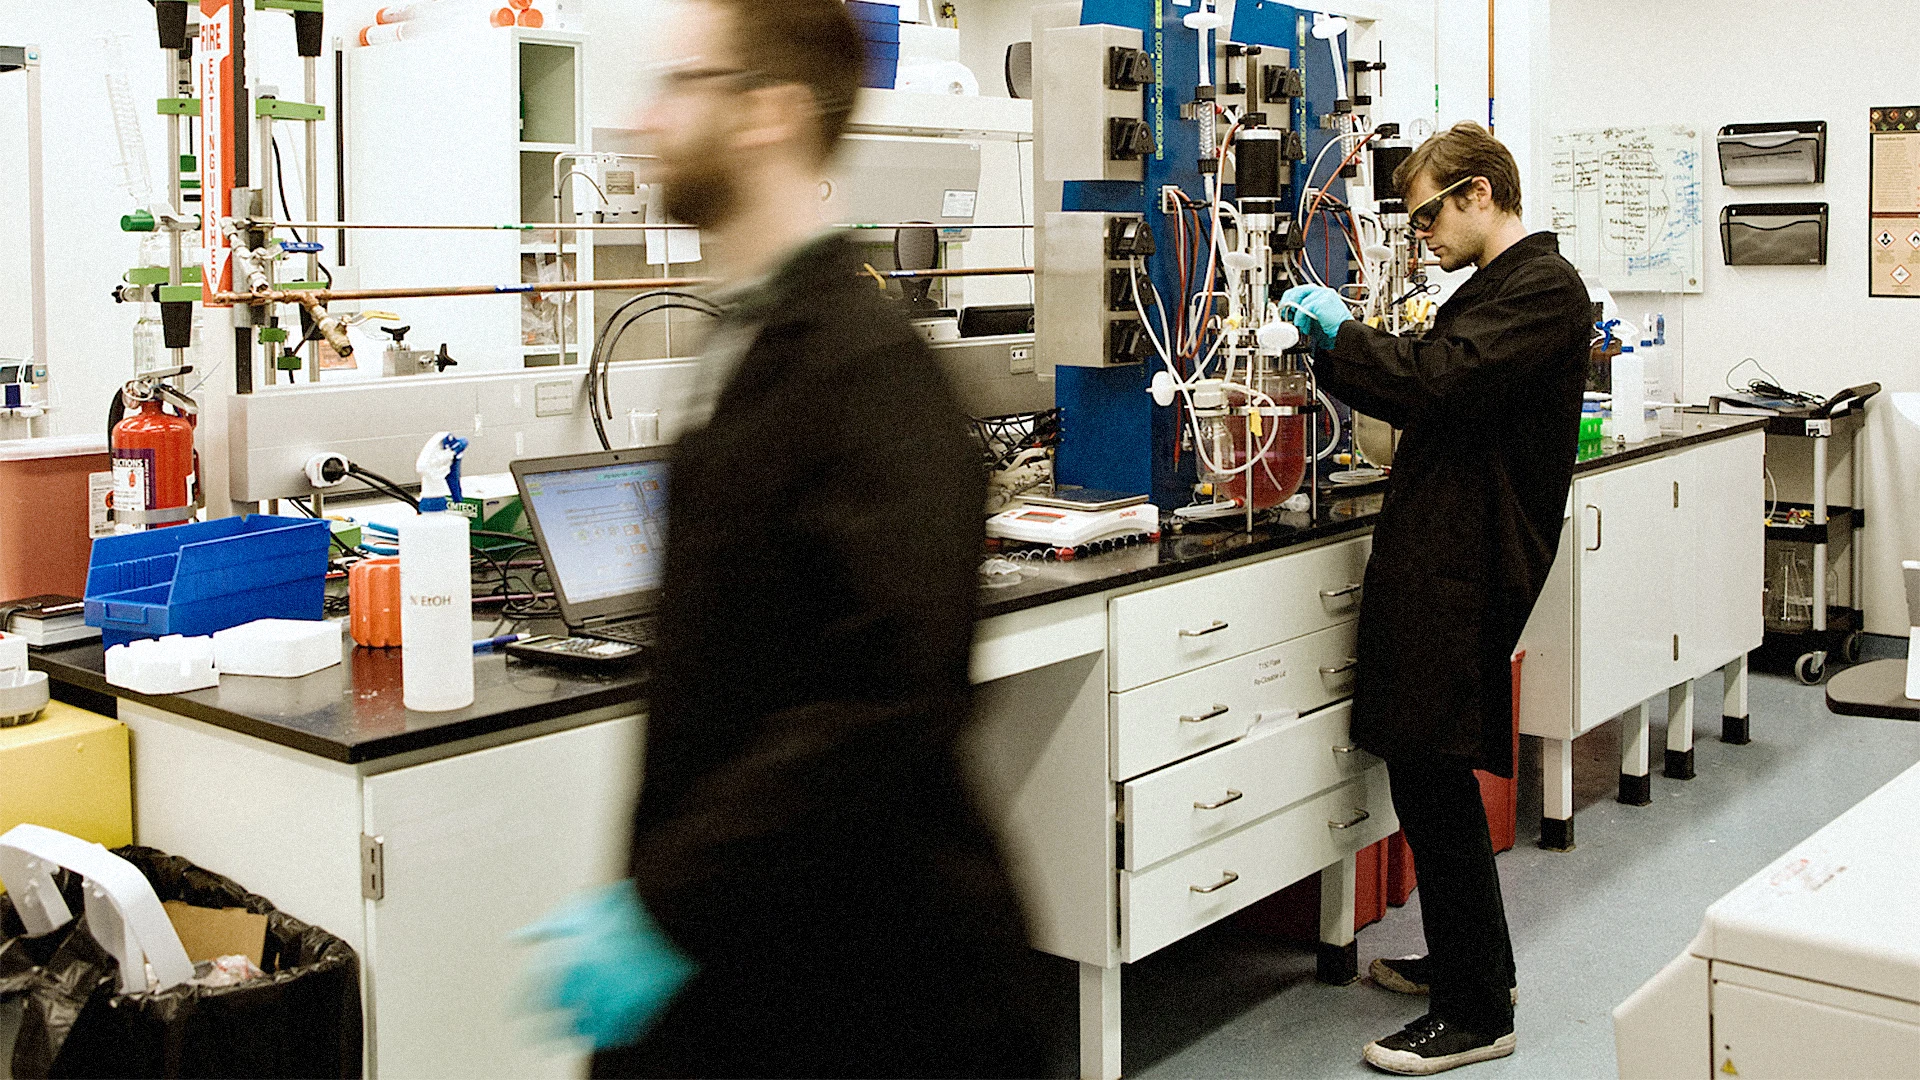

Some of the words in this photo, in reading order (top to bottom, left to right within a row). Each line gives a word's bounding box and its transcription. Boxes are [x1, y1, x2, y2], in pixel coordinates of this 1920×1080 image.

[200, 23, 221, 52] FIRE
[208, 58, 218, 284] EXTINGUISHER
[421, 594, 452, 607] EtOH
